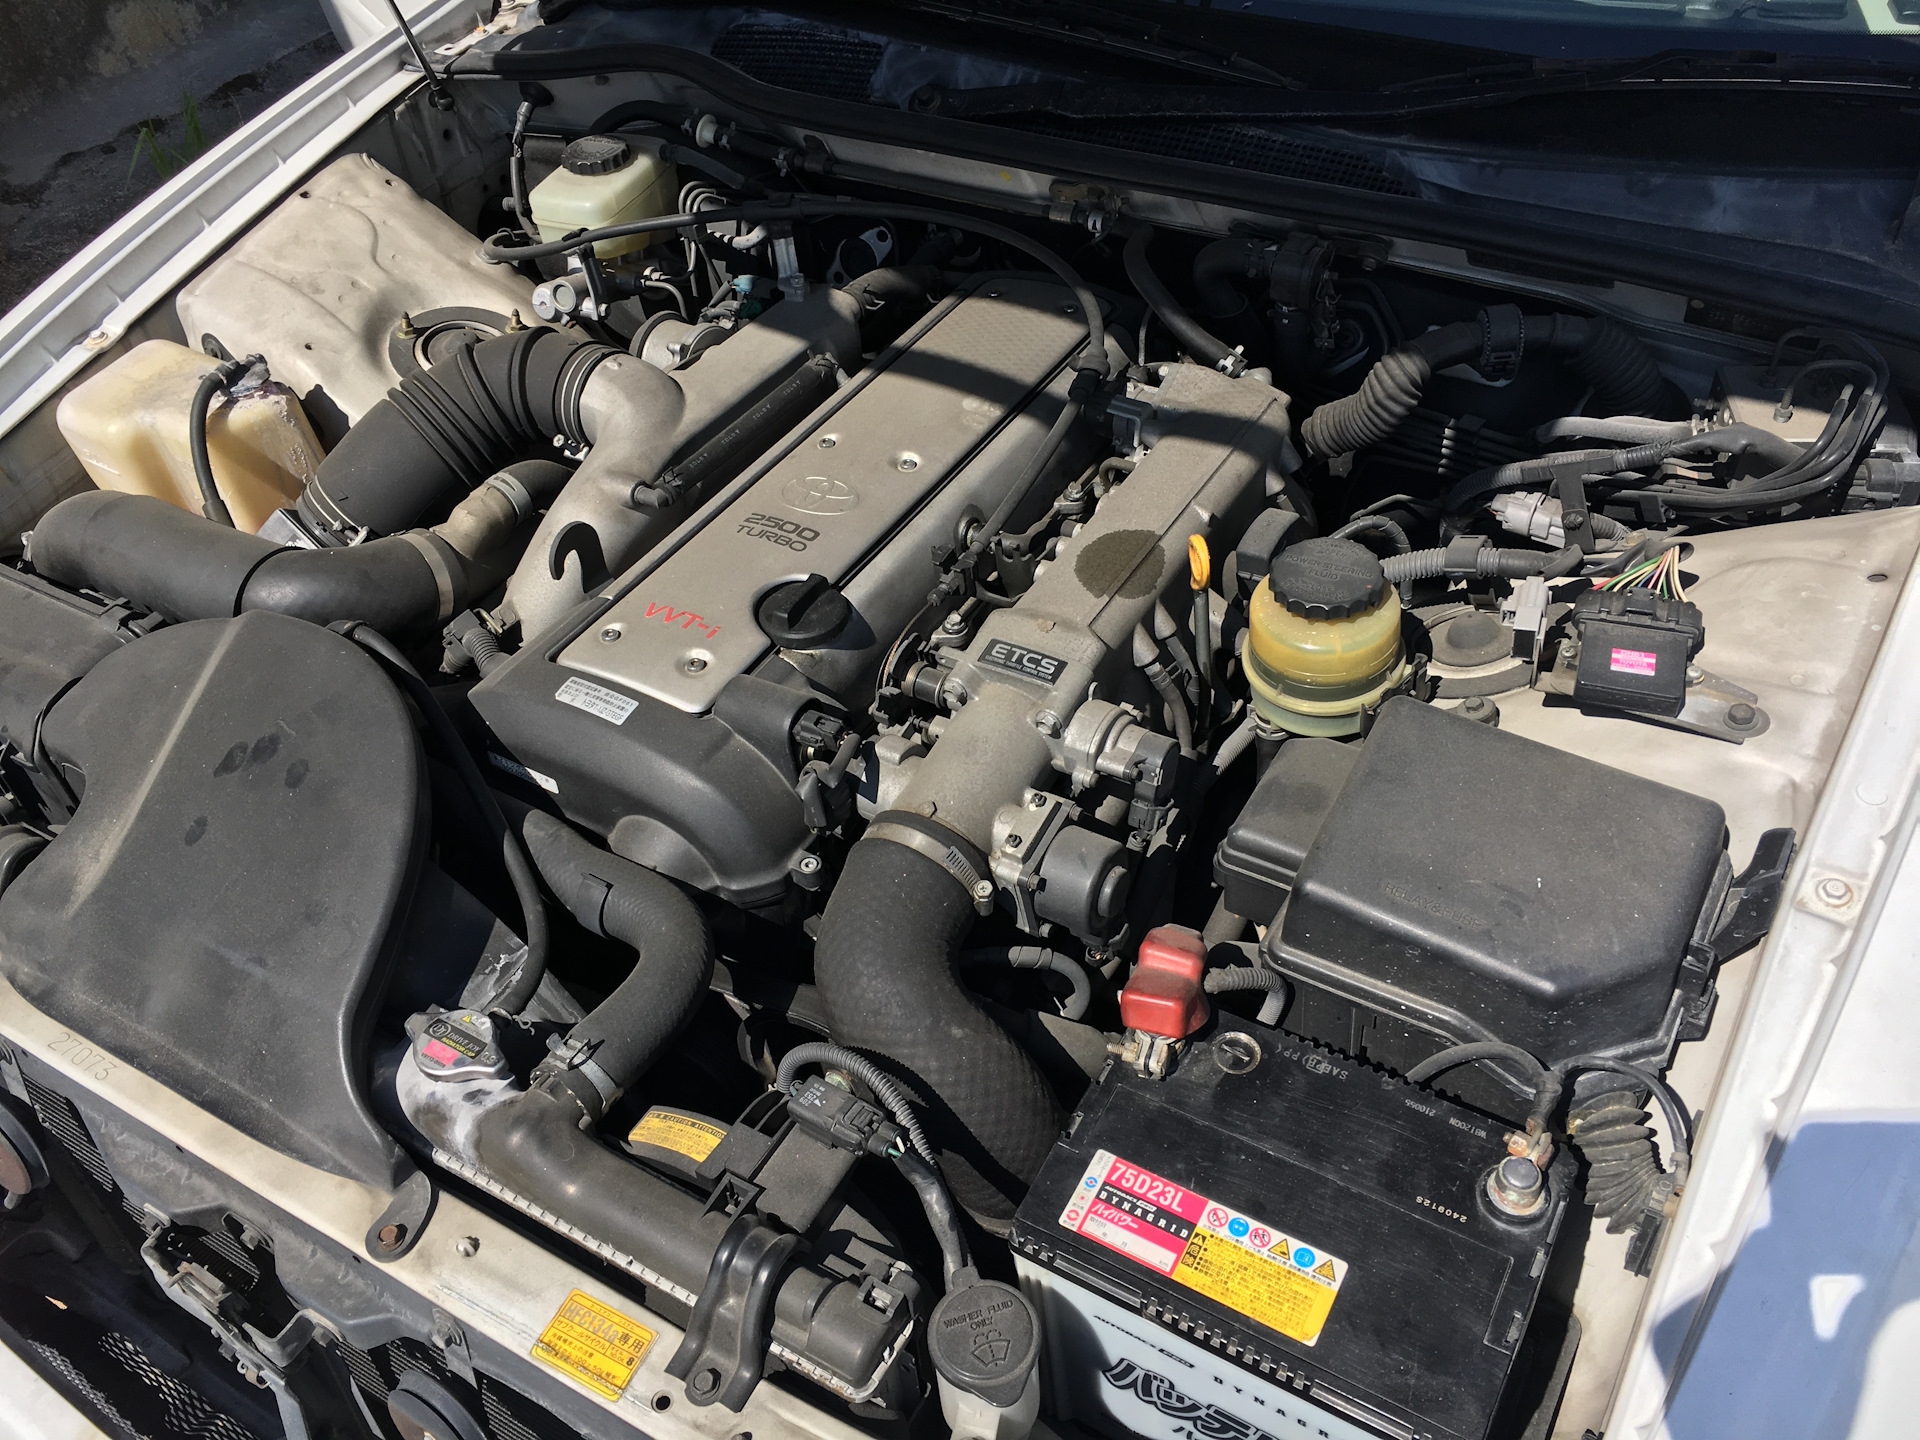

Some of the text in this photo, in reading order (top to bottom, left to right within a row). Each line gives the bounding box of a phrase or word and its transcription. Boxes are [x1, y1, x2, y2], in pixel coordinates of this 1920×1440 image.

[737, 524, 807, 551] TURBO
[743, 512, 820, 541] 2500
[1284, 554, 1374, 578] POWER STEERING
[1308, 568, 1339, 580] FLUID
[645, 602, 721, 639] VVT-i
[991, 643, 1059, 674] ETCS
[47, 1031, 118, 1081] 27073
[447, 1032, 468, 1046] DRIVE
[466, 1043, 482, 1053] JOY
[666, 1115, 693, 1126] CAUTION
[1110, 1162, 1183, 1213] 75D23L
[1091, 1203, 1139, 1229] ハイパワー
[1099, 1190, 1189, 1239] DYNAGRID
[1416, 1196, 1467, 1223] 240912S
[1182, 1243, 1199, 1268] 危険
[943, 1299, 1014, 1329] WASHER FLUID
[970, 1316, 993, 1331] ONLY
[563, 1302, 645, 1354] HFC134a 専用
[626, 1356, 635, 1367] 8
